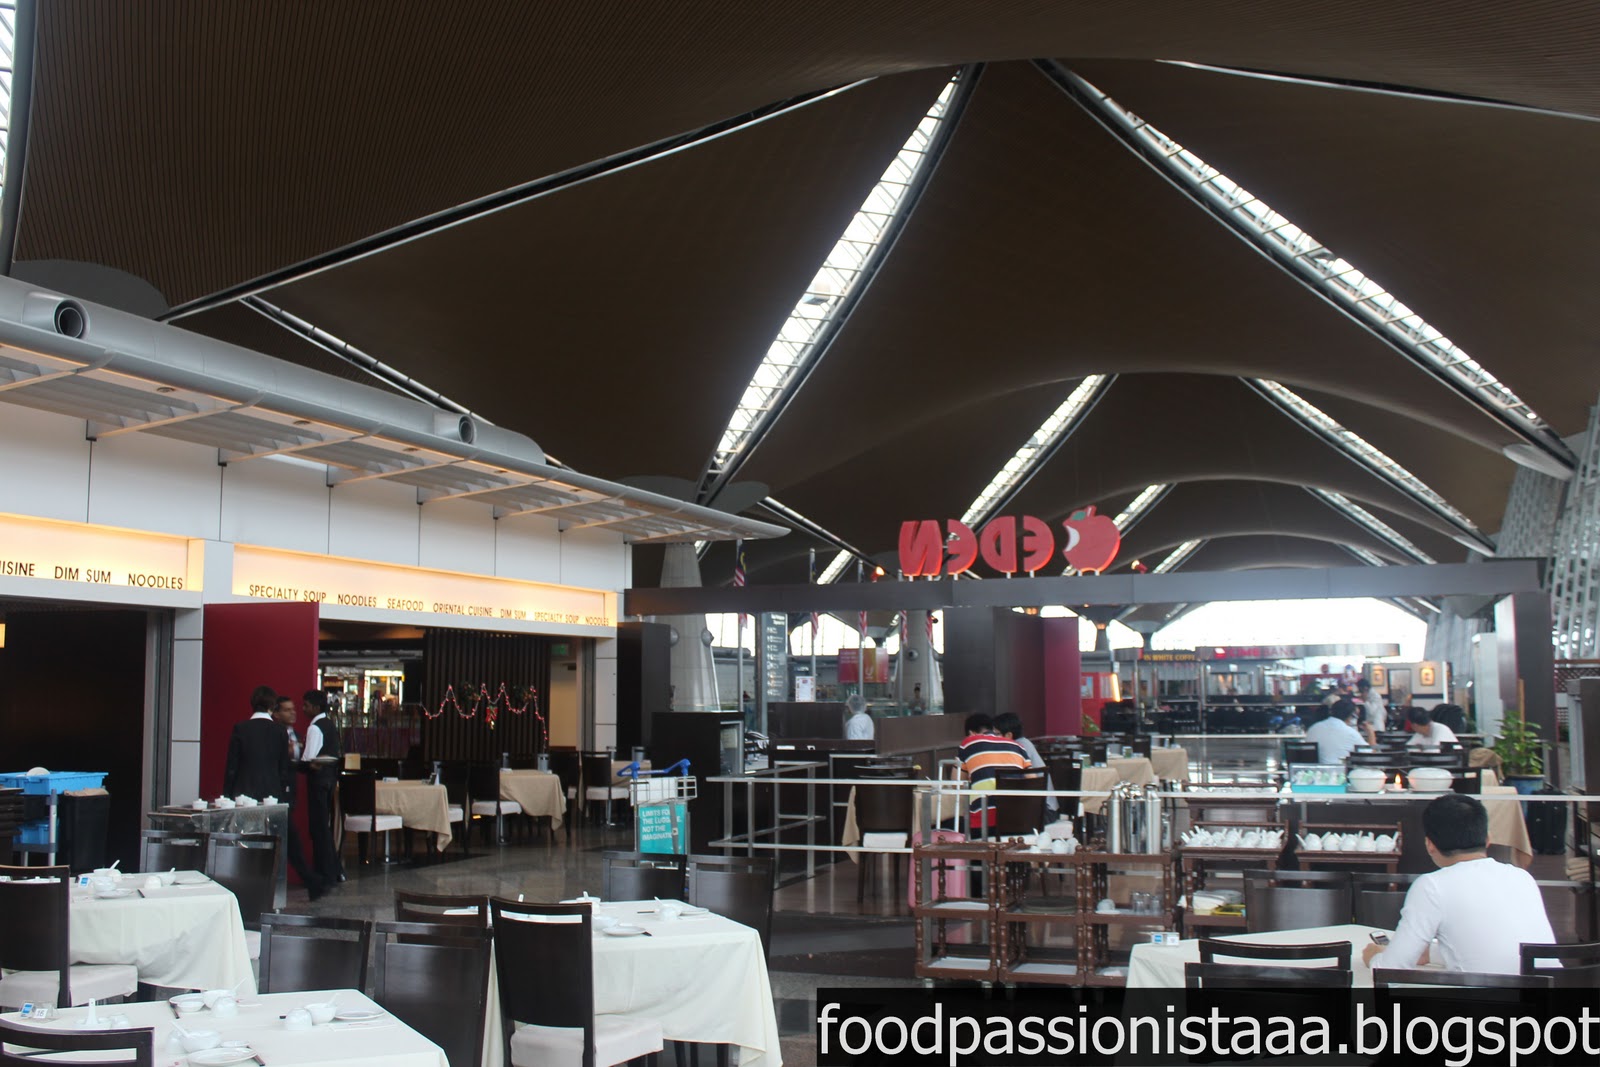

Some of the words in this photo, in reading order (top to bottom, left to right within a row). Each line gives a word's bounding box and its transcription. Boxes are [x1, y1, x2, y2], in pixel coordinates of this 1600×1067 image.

[0, 560, 35, 577] ISINE
[54, 565, 79, 581] DIM
[86, 568, 111, 584] SUM
[128, 573, 183, 590] NOODLES
[249, 584, 298, 600] SPECIALTY
[303, 589, 326, 603] SOUP
[338, 593, 377, 608] NOODLES
[387, 597, 424, 612] SEAFOOD
[433, 602, 465, 615] ORIENTAL
[468, 605, 493, 617] CUISINE
[500, 608, 512, 619] DIM
[514, 610, 526, 620] SUM
[565, 614, 579, 624] SOUP
[585, 616, 609, 627] NOODLES
[1264, 647, 1296, 657] BANK
[642, 832, 673, 840] IMAGINATI
